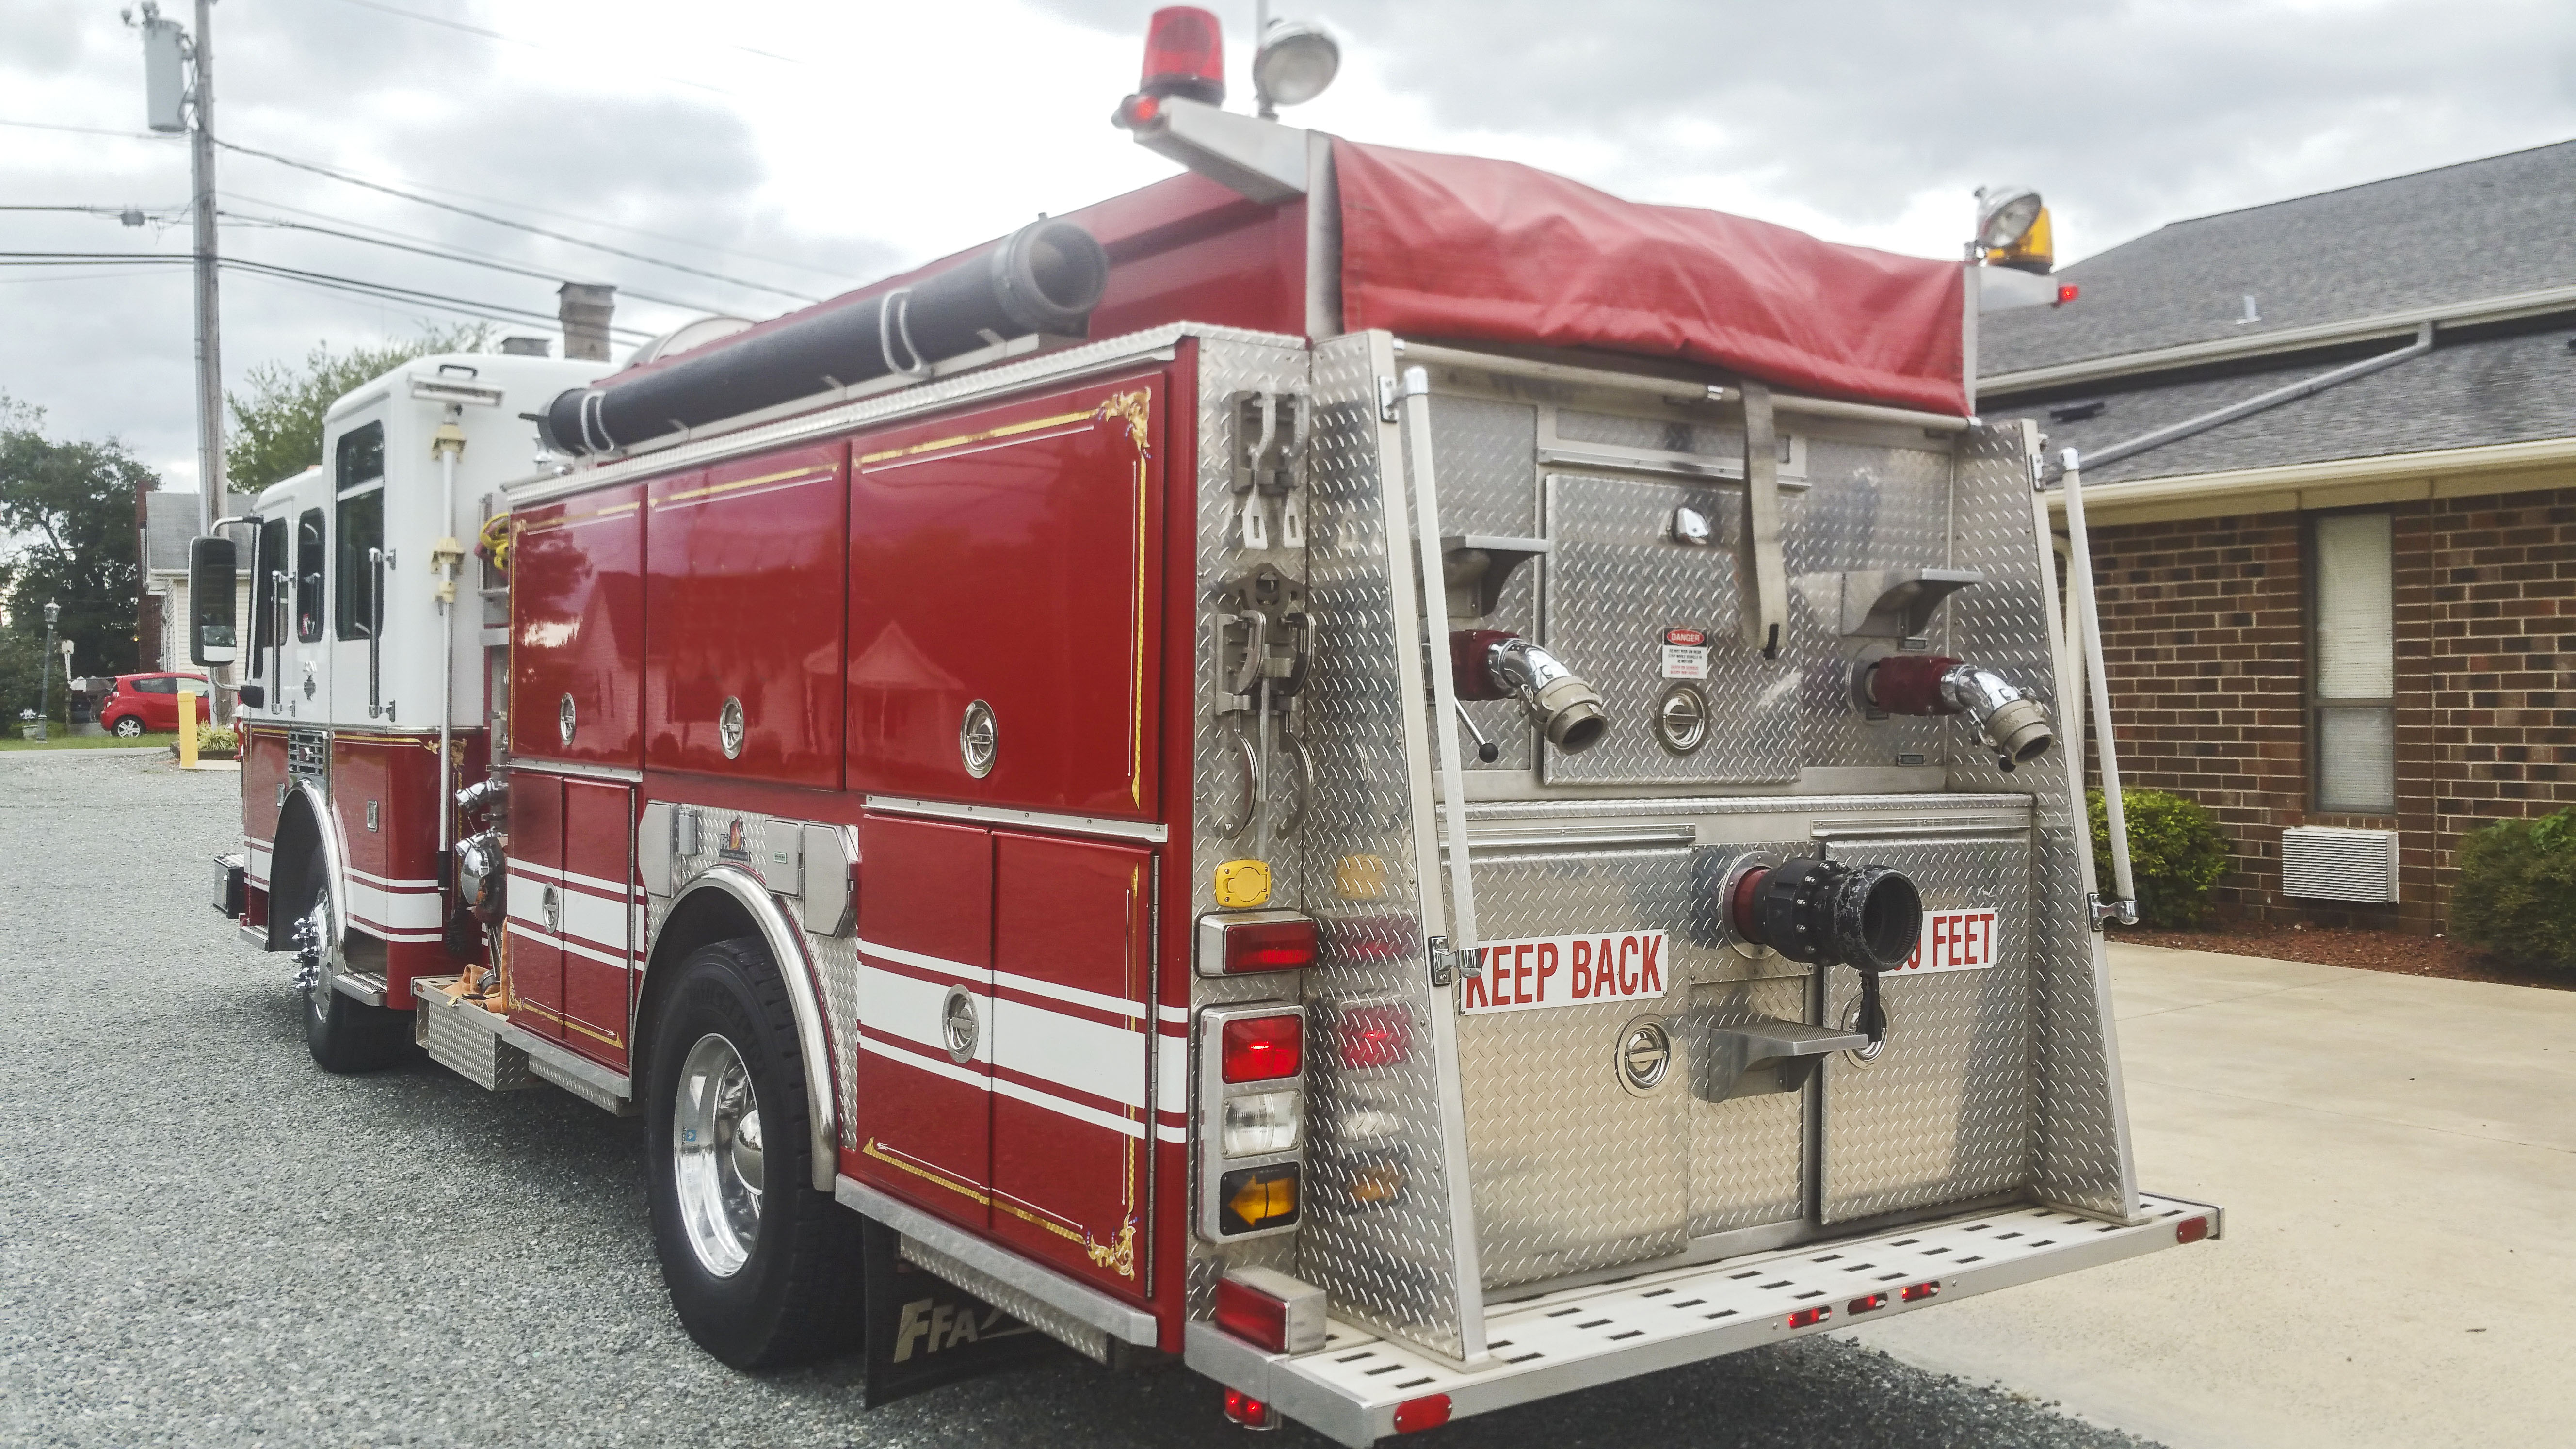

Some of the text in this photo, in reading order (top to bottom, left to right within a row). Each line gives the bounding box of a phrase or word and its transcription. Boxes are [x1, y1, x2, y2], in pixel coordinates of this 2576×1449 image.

[1671, 633, 1700, 642] DANGER
[1466, 943, 1558, 1008] KEEP
[1572, 935, 1663, 999] BACK
[1932, 913, 1995, 967] FEET
